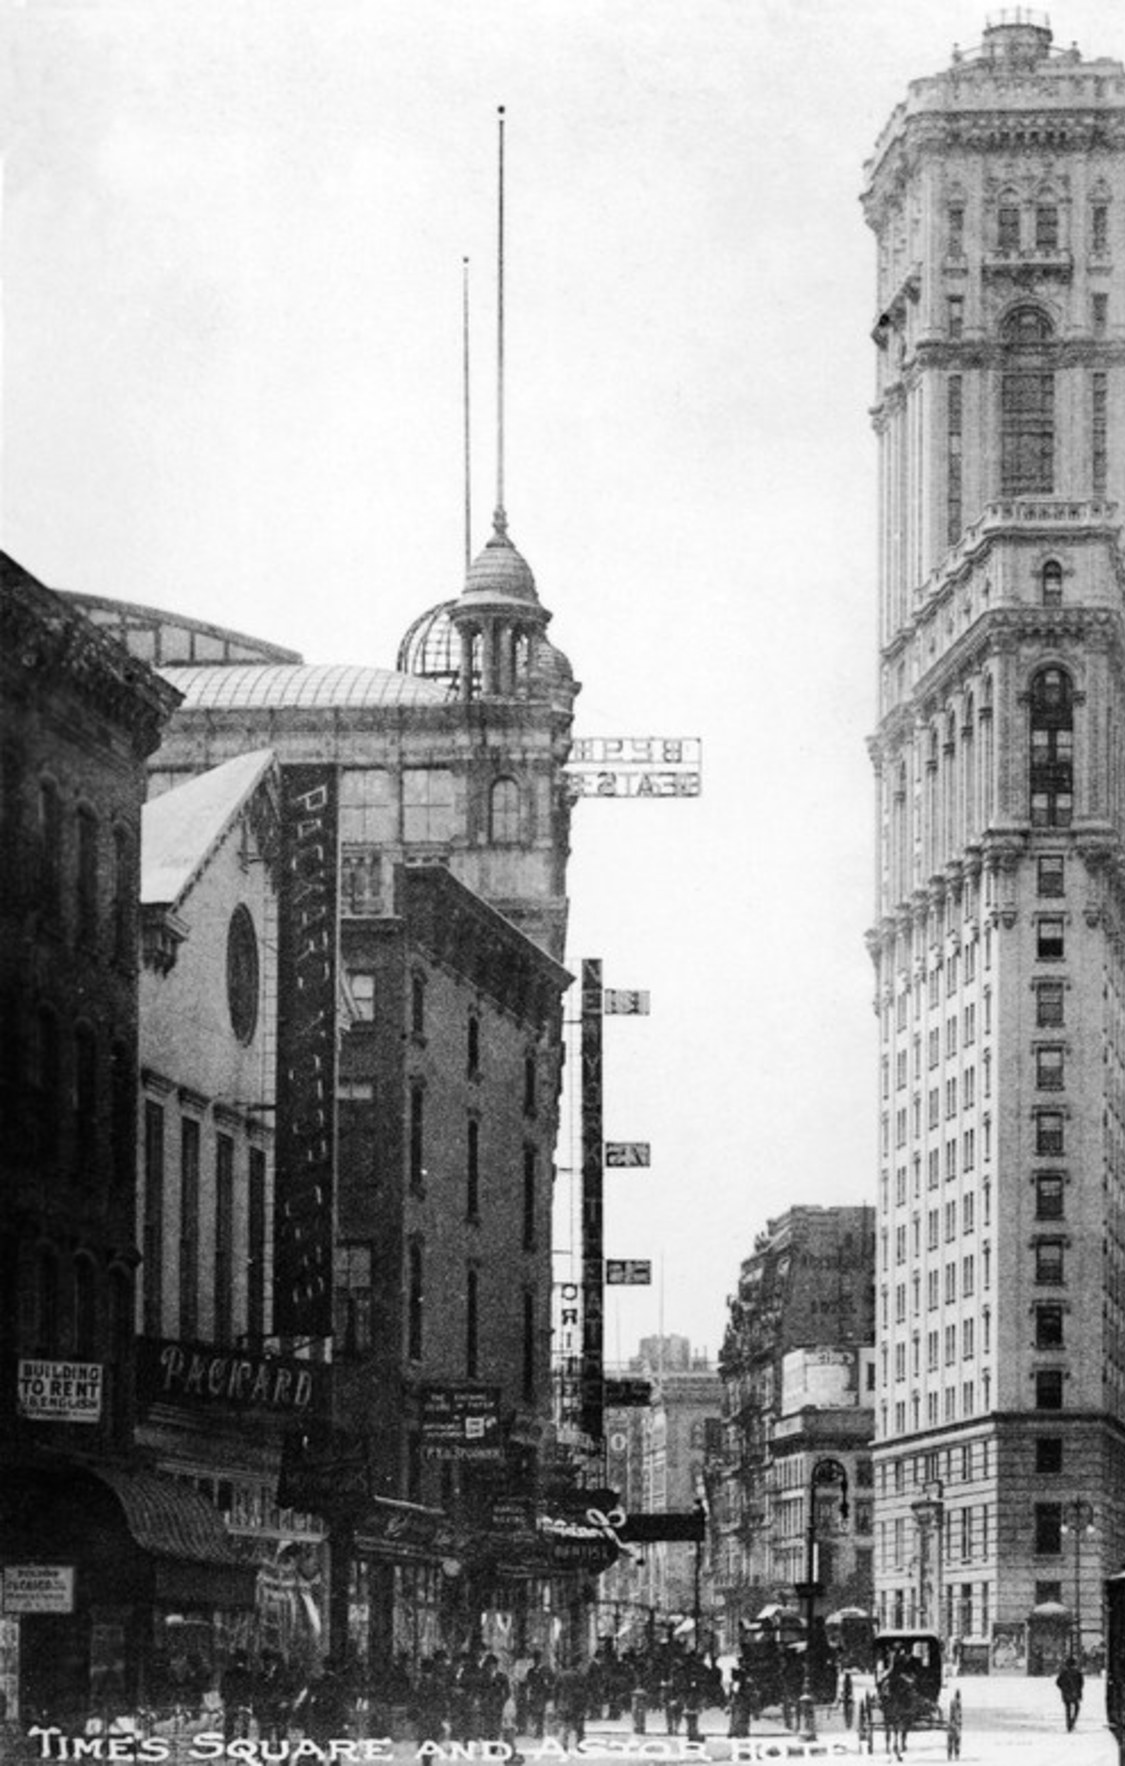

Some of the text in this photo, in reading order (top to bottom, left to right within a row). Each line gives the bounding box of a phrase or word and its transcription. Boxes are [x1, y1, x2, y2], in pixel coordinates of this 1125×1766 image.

[23, 1363, 99, 1381] BUILDING
[161, 1345, 313, 1406] PACKARD
[20, 1379, 99, 1398] TO RENT
